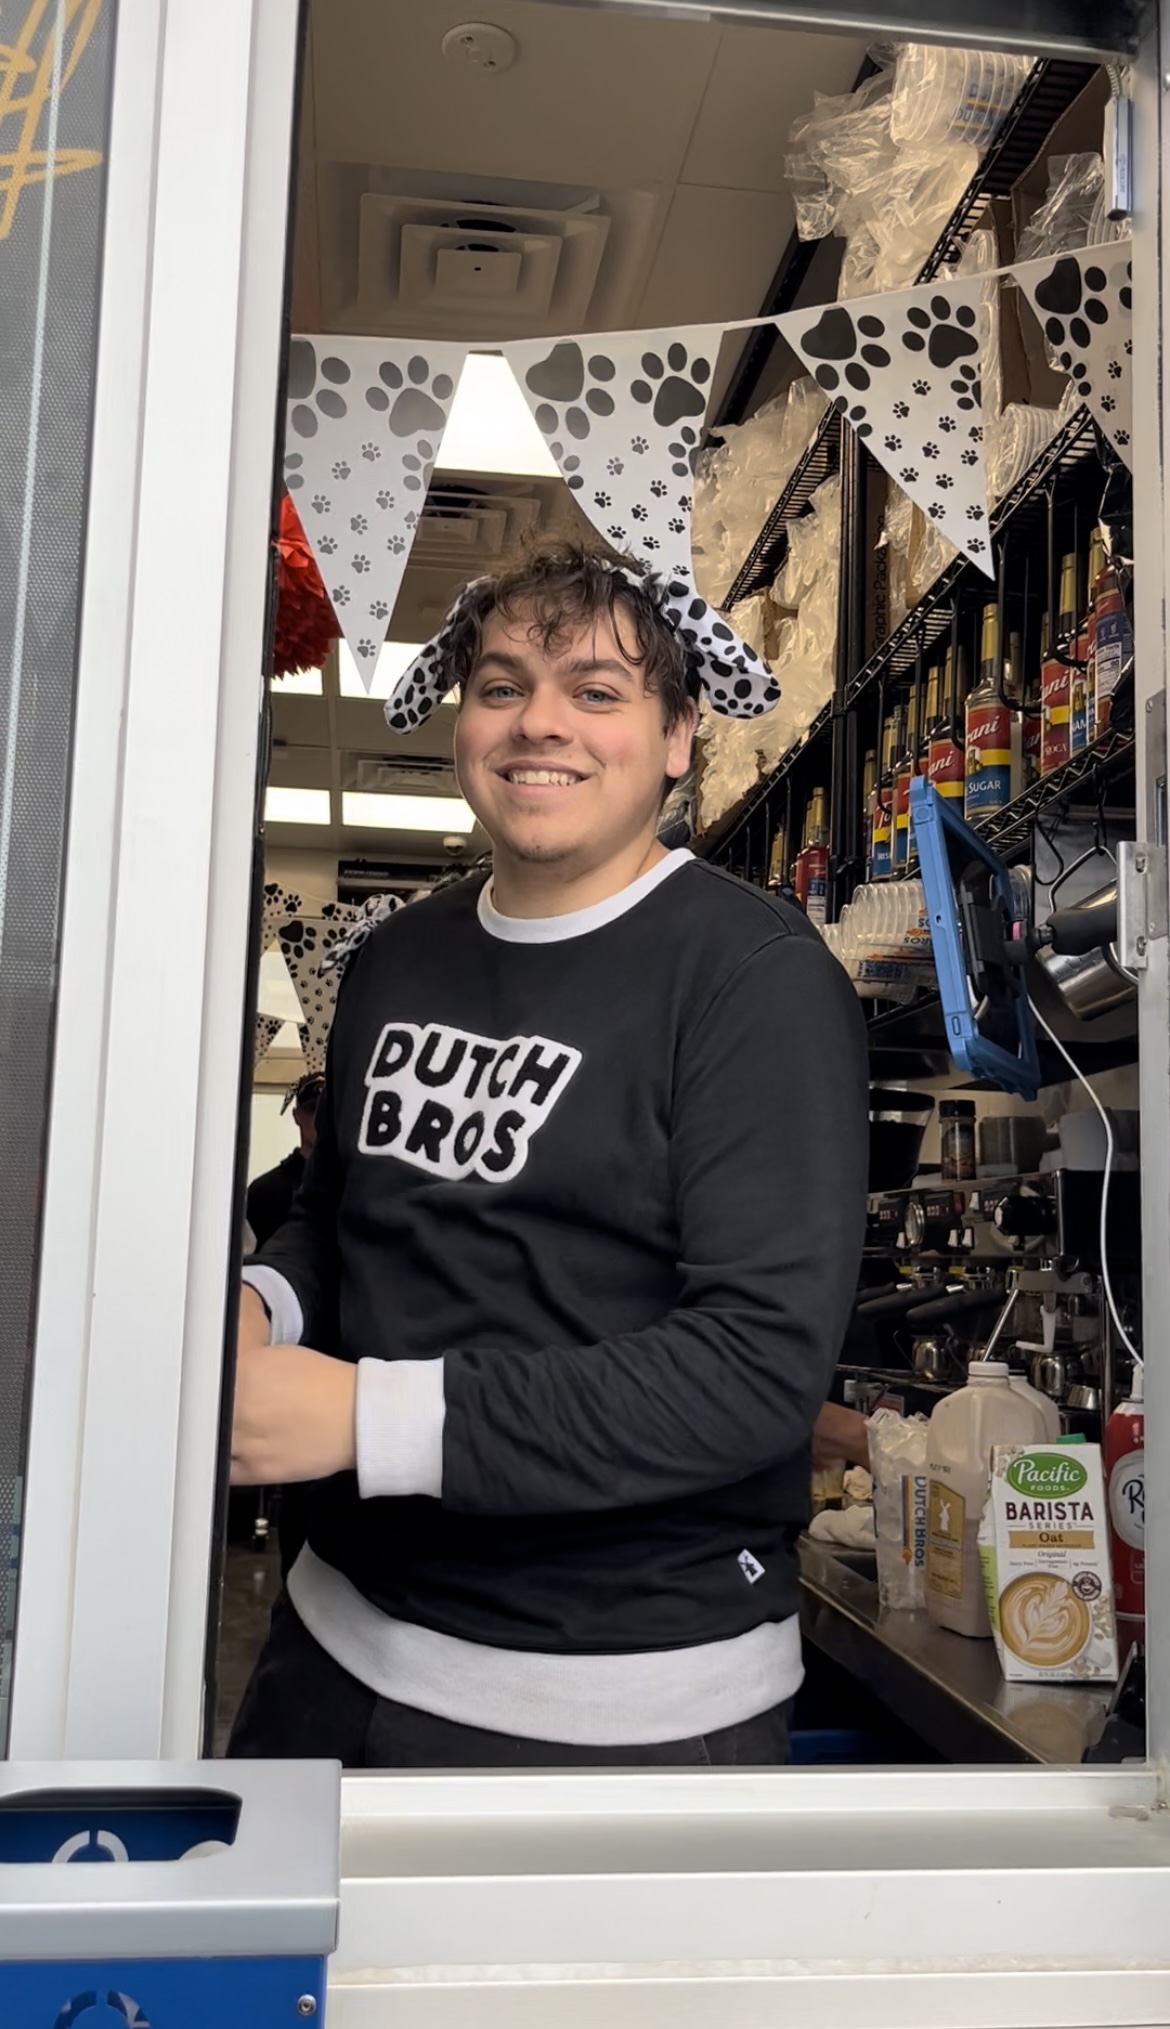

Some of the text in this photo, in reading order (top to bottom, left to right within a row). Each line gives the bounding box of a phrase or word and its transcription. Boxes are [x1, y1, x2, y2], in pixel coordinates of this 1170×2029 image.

[968, 780, 1001, 794] SUGAR
[372, 1029, 571, 1106] DUTCH
[366, 1090, 526, 1173] BROS
[1013, 1459, 1081, 1485] Pacific
[914, 1476, 927, 1567] DUTCH BROS
[1005, 1502, 1095, 1521] BARISTA
[1038, 1531, 1064, 1543] Oat
[1037, 1550, 1067, 1559] Original
